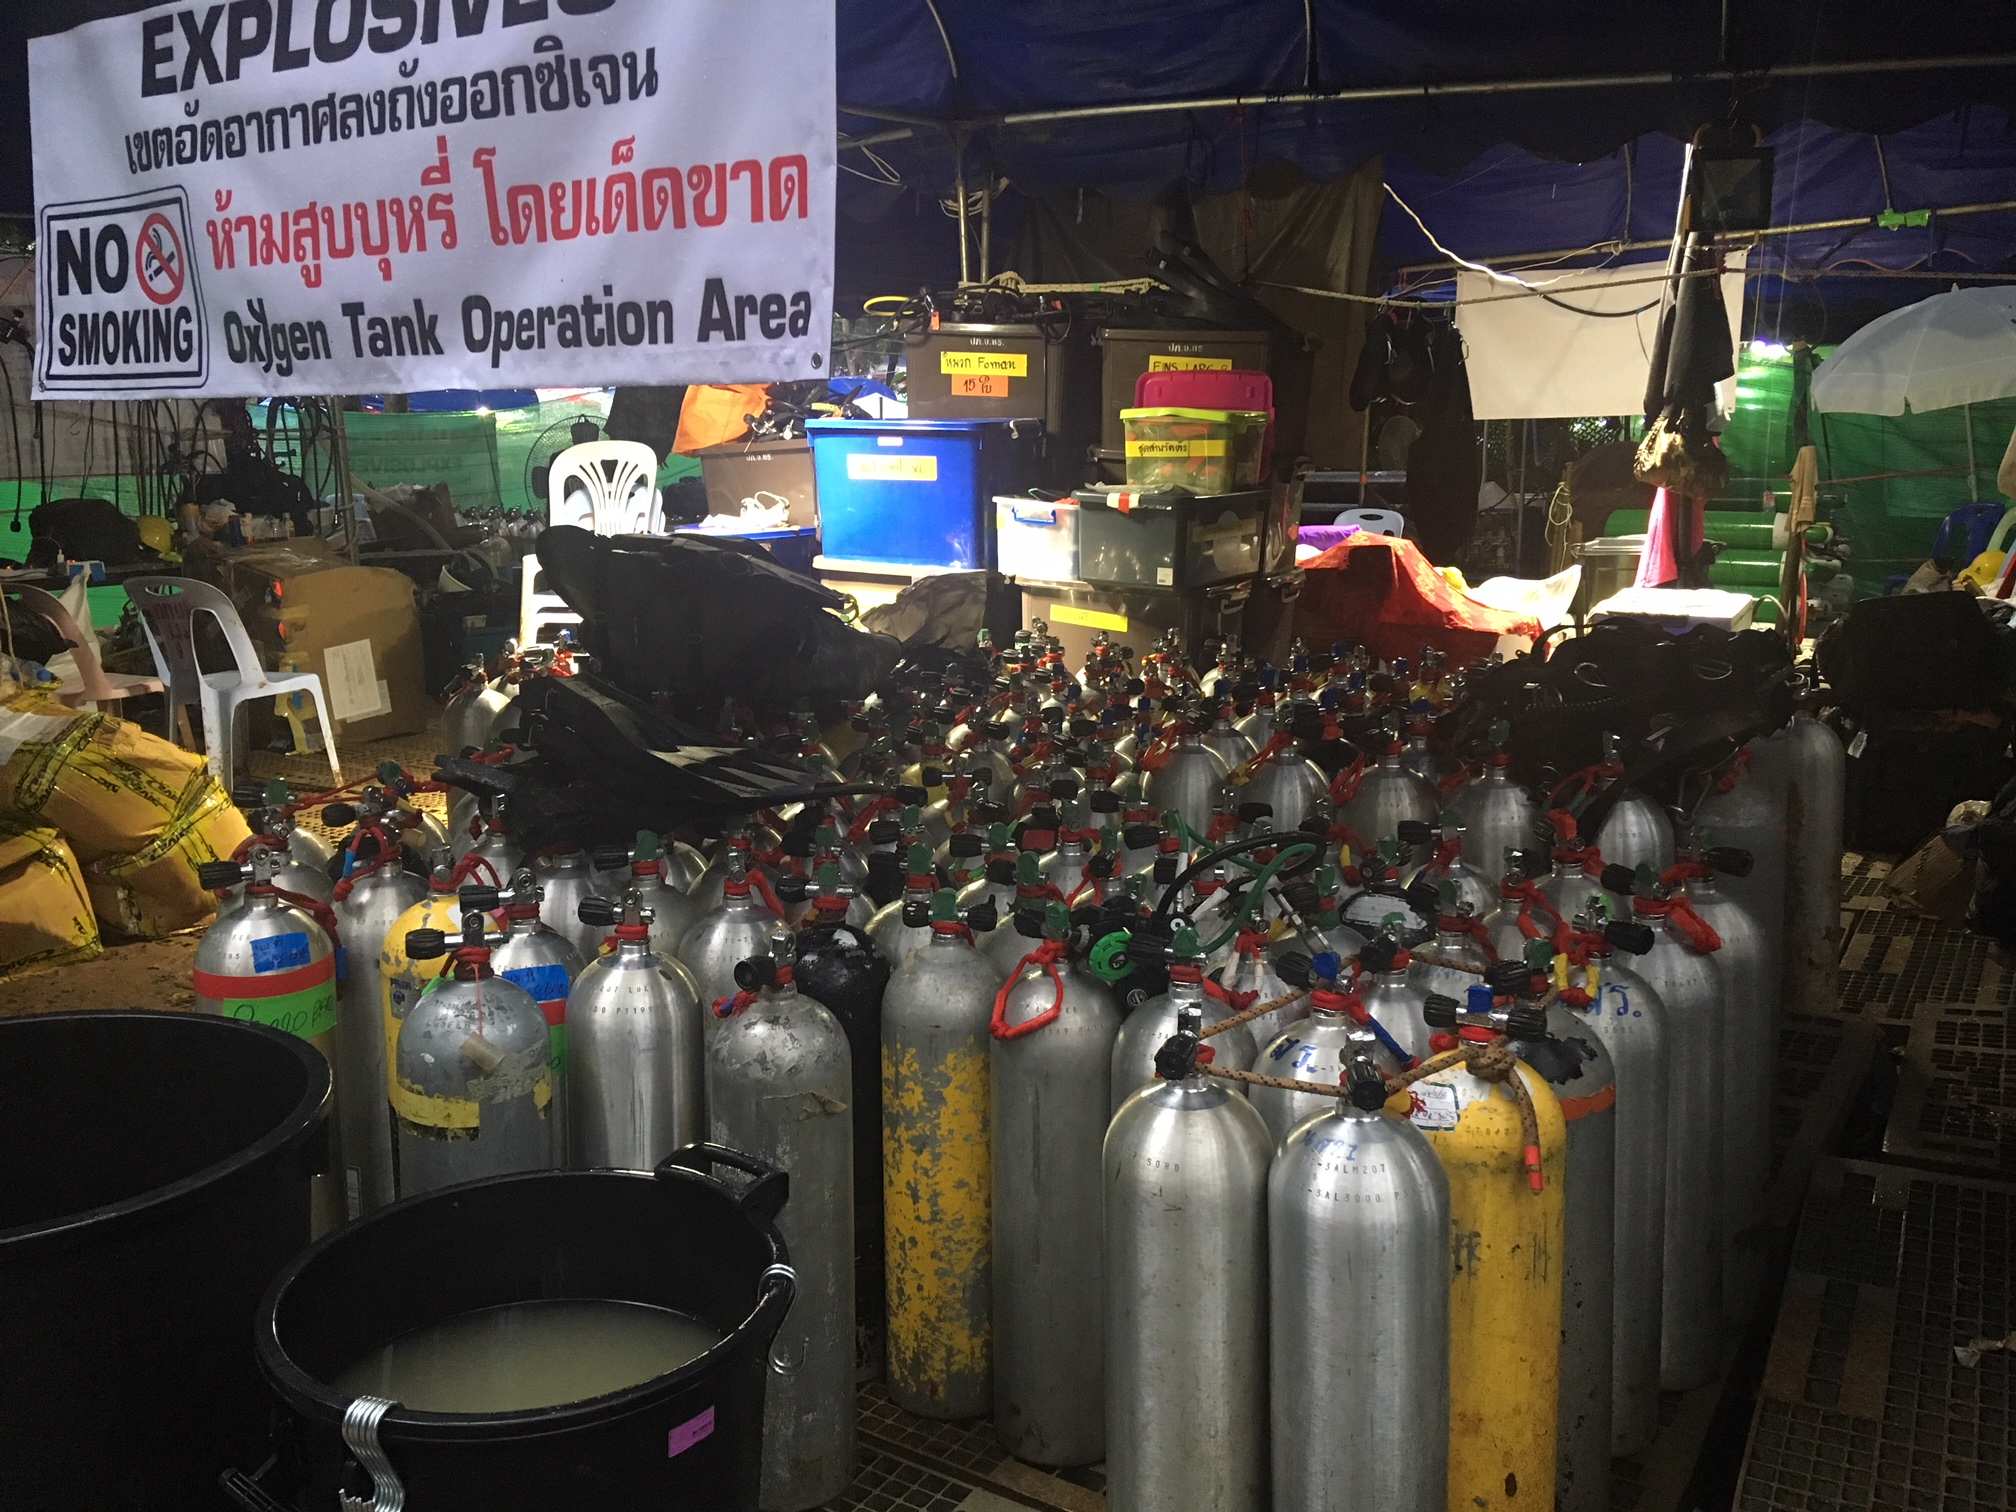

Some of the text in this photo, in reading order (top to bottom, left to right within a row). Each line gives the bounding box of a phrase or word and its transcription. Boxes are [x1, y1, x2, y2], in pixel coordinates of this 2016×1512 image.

[125, 35, 659, 174] เขตอัดอากาศลงถังออกซิเจน
[56, 224, 129, 296] NO
[206, 135, 808, 288] ห้ามสูบบุหรี่ โดยเด็ดขาด
[58, 306, 194, 367] SMOKING
[223, 277, 812, 377] Oxygen Tank Operation Area
